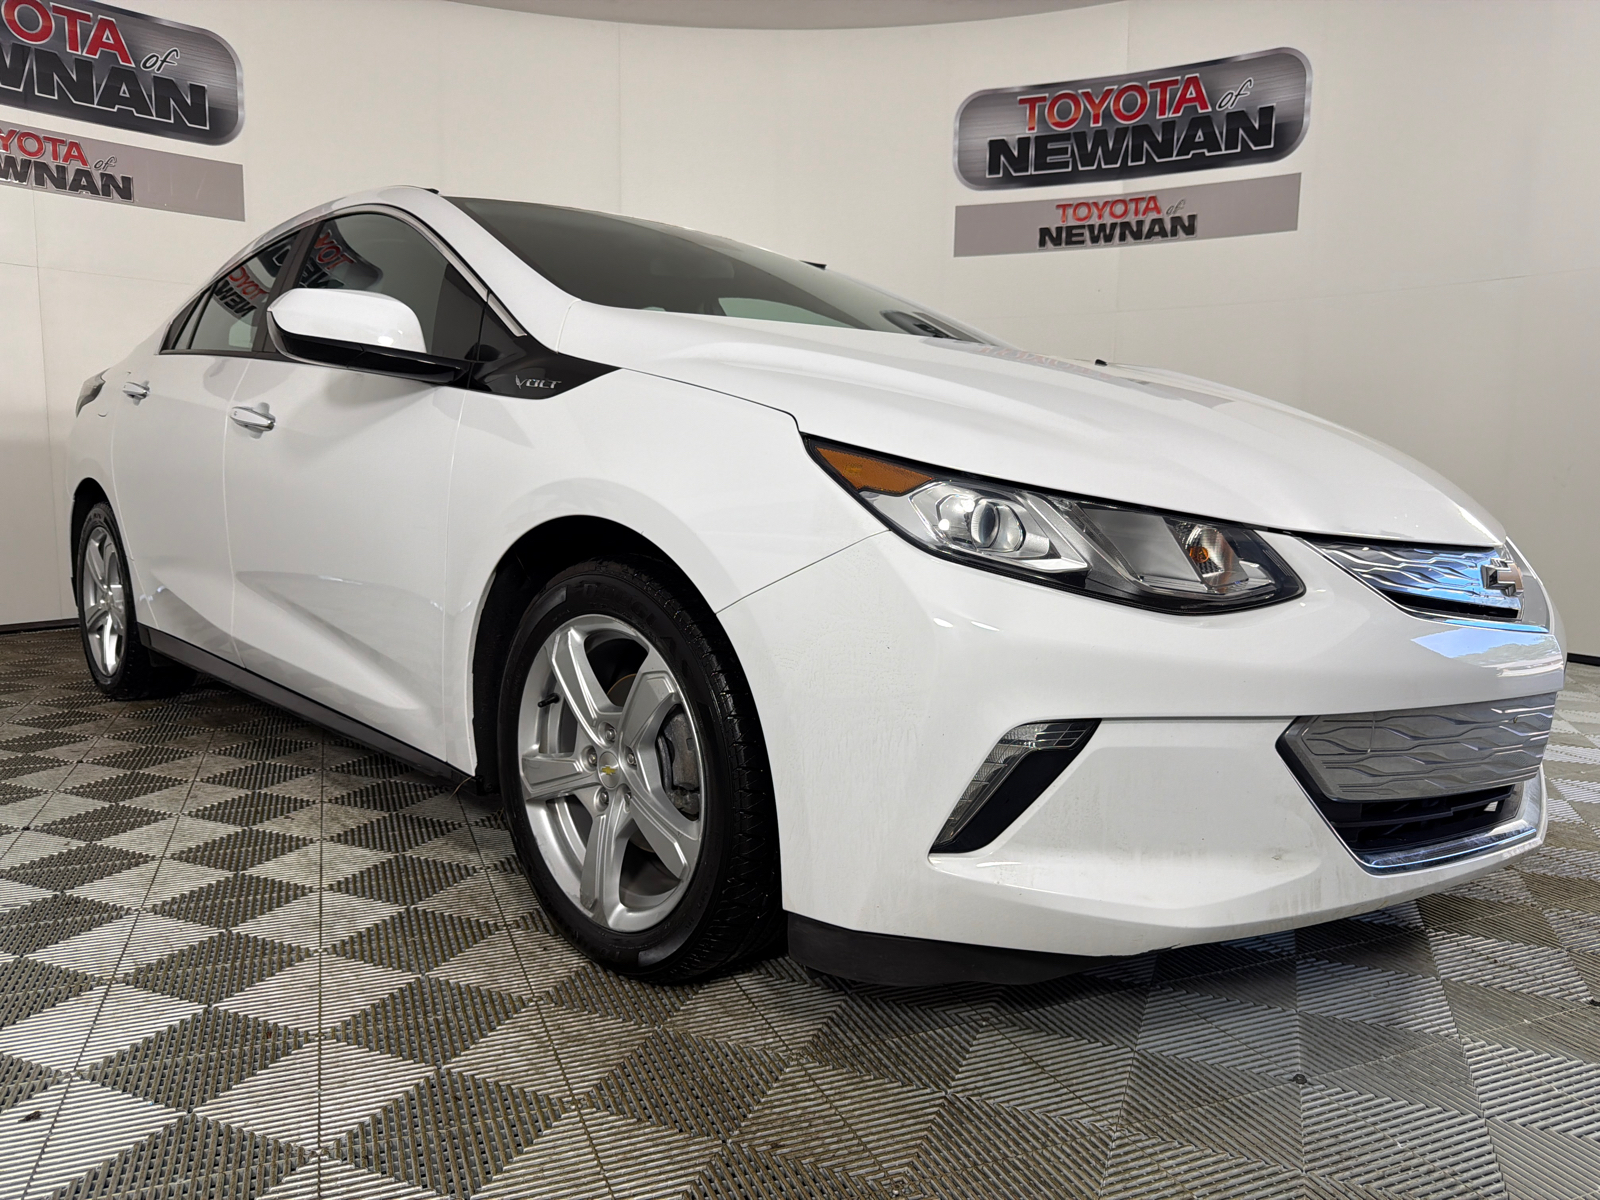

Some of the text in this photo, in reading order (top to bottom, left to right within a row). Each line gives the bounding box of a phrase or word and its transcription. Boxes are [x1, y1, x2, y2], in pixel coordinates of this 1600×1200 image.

[140, 48, 180, 73] of
[1018, 74, 1253, 132] TOYOTA of
[986, 104, 1277, 177] NEWNAN
[94, 156, 117, 171] of
[1056, 195, 1186, 223] TOYOTA of
[1038, 214, 1198, 248] NEWNAN
[515, 374, 562, 389] VOLT
